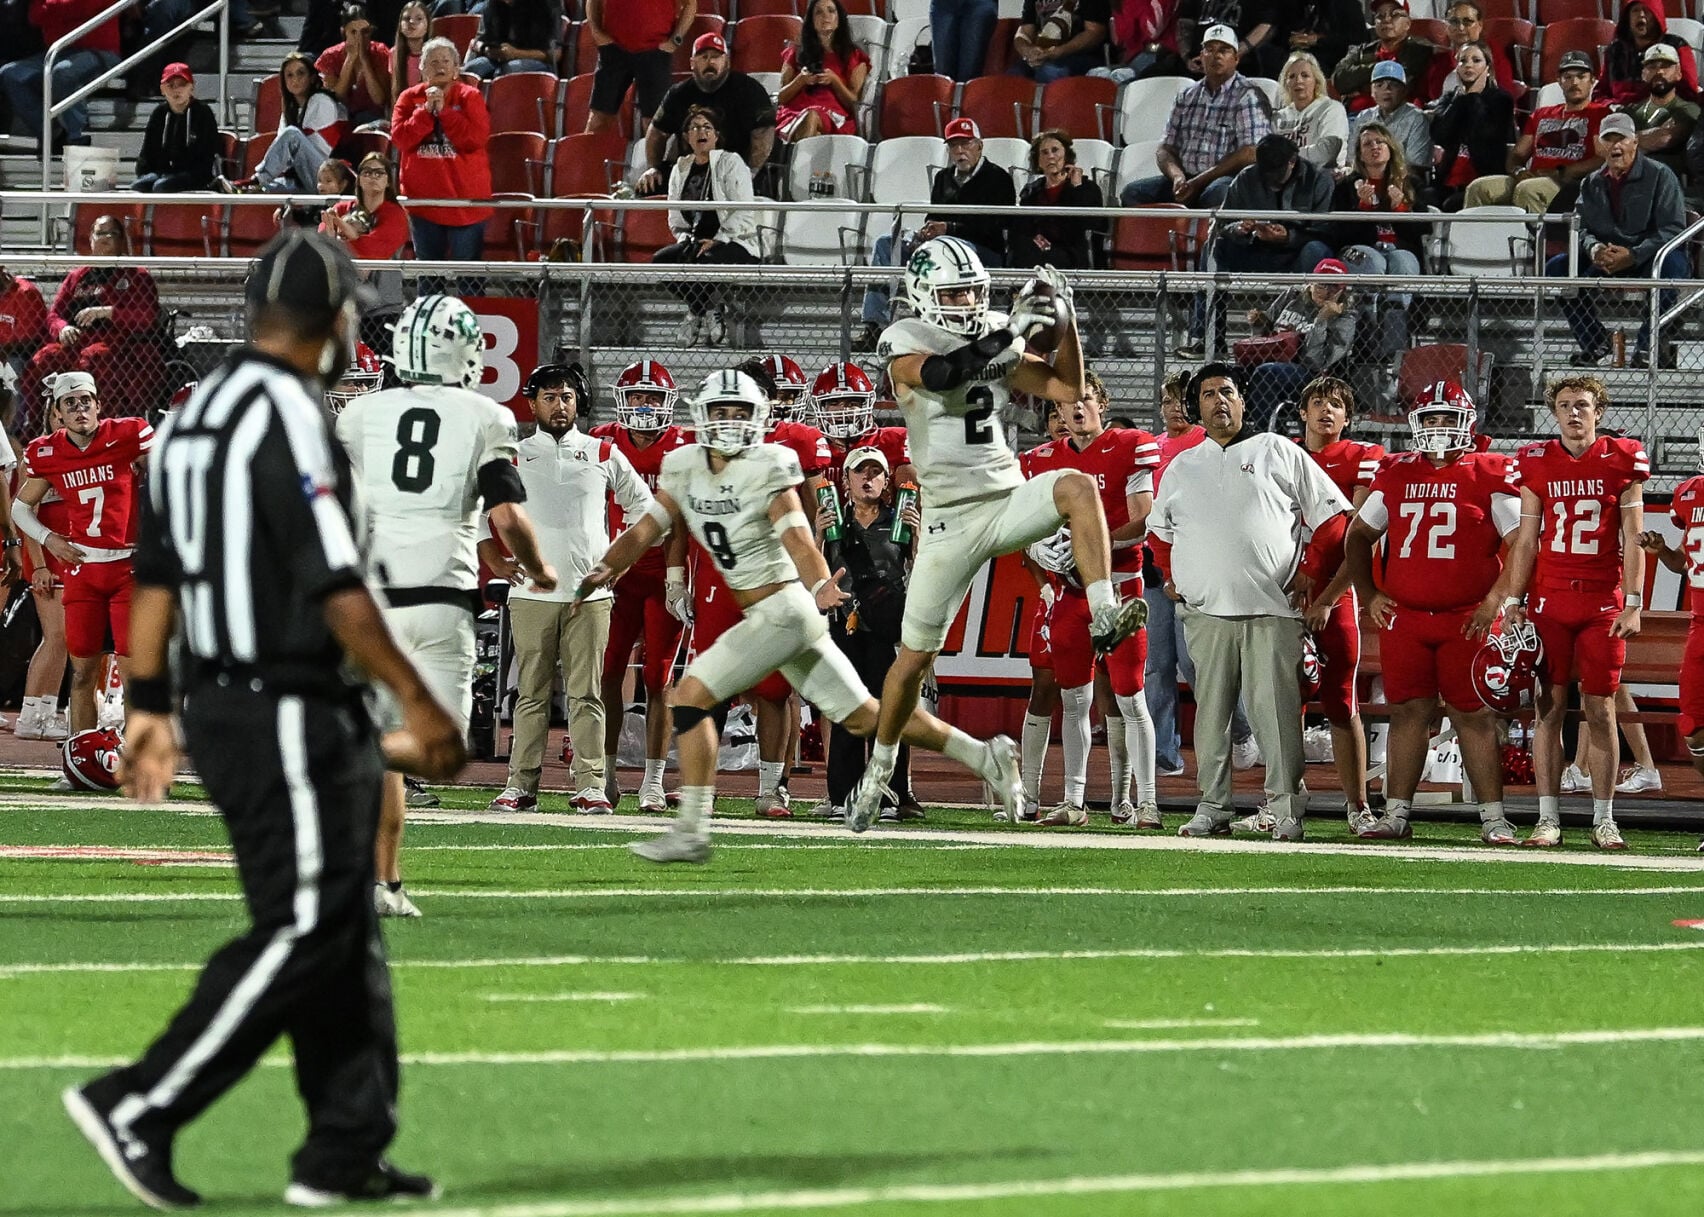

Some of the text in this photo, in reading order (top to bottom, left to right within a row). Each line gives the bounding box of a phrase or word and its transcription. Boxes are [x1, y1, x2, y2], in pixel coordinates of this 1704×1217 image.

[964, 386, 994, 444] 2
[391, 407, 441, 494] 8
[62, 464, 114, 489] INDIANS
[1404, 483, 1457, 499] INDIANS
[1548, 479, 1604, 498] INDIANS
[78, 486, 105, 537] 7
[1400, 502, 1457, 560] 72
[1551, 499, 1601, 555] 12
[702, 521, 738, 570] 9
[705, 586, 717, 603] J
[1535, 597, 1546, 614] J
